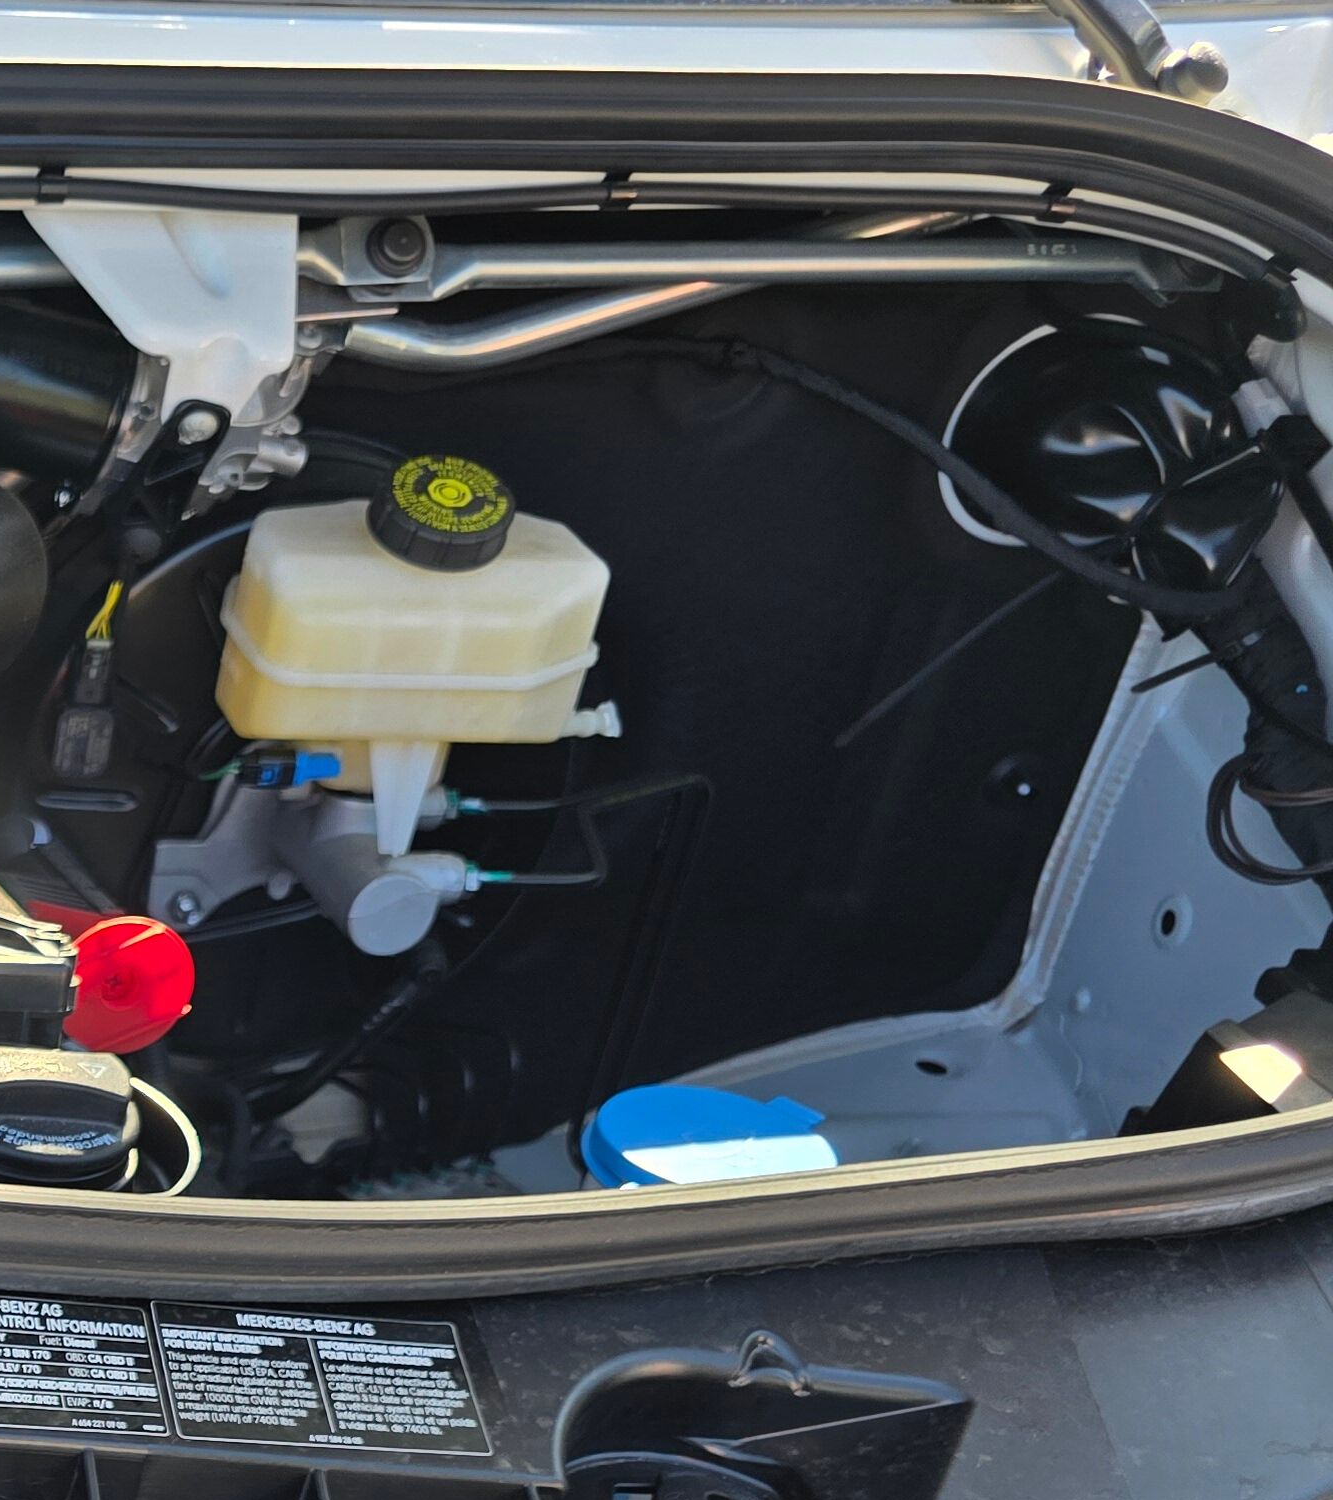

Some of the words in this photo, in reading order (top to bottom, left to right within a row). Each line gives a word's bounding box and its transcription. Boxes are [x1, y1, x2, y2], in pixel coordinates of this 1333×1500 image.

[40, 1303, 64, 1318] AG
[46, 1318, 146, 1339] INFORMATION
[235, 1313, 353, 1336] MERCEDES-BENZ
[353, 1322, 377, 1337] AG
[38, 1334, 62, 1347] Fuel:
[63, 1338, 99, 1350] Diesel
[161, 1328, 217, 1342] IMPORTANT
[217, 1332, 286, 1348] INFORMATION
[163, 1338, 185, 1349] FOR
[184, 1340, 213, 1351] BODY
[212, 1342, 263, 1355] BUILDERS
[65, 1352, 88, 1364] OBD:
[87, 1353, 103, 1365] CA
[103, 1355, 126, 1366] OBD
[166, 1351, 186, 1362] This
[186, 1353, 220, 1365] vehicle
[219, 1356, 239, 1366] and
[238, 1357, 270, 1370] engine
[270, 1359, 310, 1371] conform
[319, 1350, 347, 1362] POUR
[68, 1367, 91, 1379] OBD:
[90, 1368, 106, 1380] CA
[105, 1370, 129, 1381] OBD
[168, 1361, 179, 1371] to
[239, 1366, 255, 1377] US
[323, 1362, 337, 1373] Le
[171, 1371, 189, 1382] and
[189, 1372, 233, 1385] Canadian
[233, 1376, 285, 1388] regulations
[172, 1381, 194, 1391] time
[194, 1382, 206, 1392] of
[264, 1387, 278, 1397] for
[174, 1391, 202, 1401] under
[203, 1392, 235, 1404] 10000
[280, 1397, 300, 1407] and
[185, 1401, 231, 1413] maximum
[178, 1411, 211, 1424] weight
[211, 1413, 242, 1425] (UVW)
[241, 1415, 253, 1425] of
[254, 1415, 280, 1427] 7400
[383, 1413, 415, 1425] 10000
[404, 1425, 430, 1436] 7400
